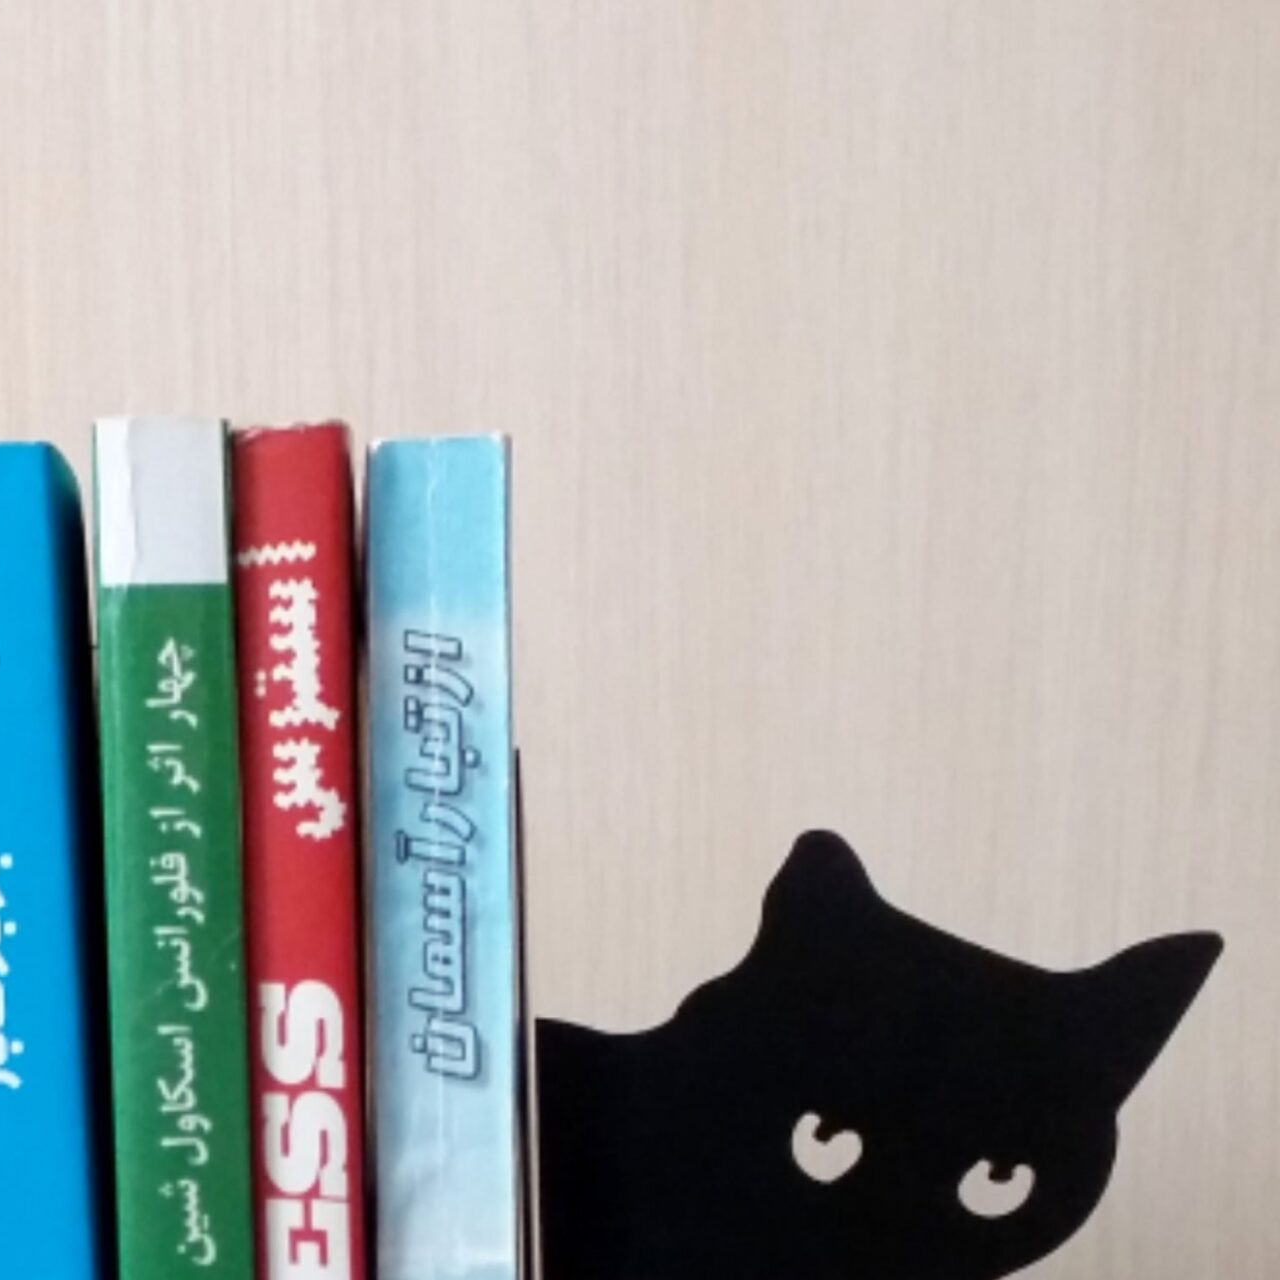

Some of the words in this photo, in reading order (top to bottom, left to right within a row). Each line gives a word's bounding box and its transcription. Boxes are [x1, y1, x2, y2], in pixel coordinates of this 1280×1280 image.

[146, 637, 197, 728] چهار
[236, 539, 348, 841] استرس
[402, 628, 474, 706] از
[148, 743, 199, 793] اثر
[150, 809, 202, 838] از
[403, 696, 481, 842] تبار
[148, 852, 207, 1011] فلورانس
[394, 830, 482, 1081] آسمان
[157, 1026, 212, 1165] اسکاول
[159, 1180, 217, 1266] شین
